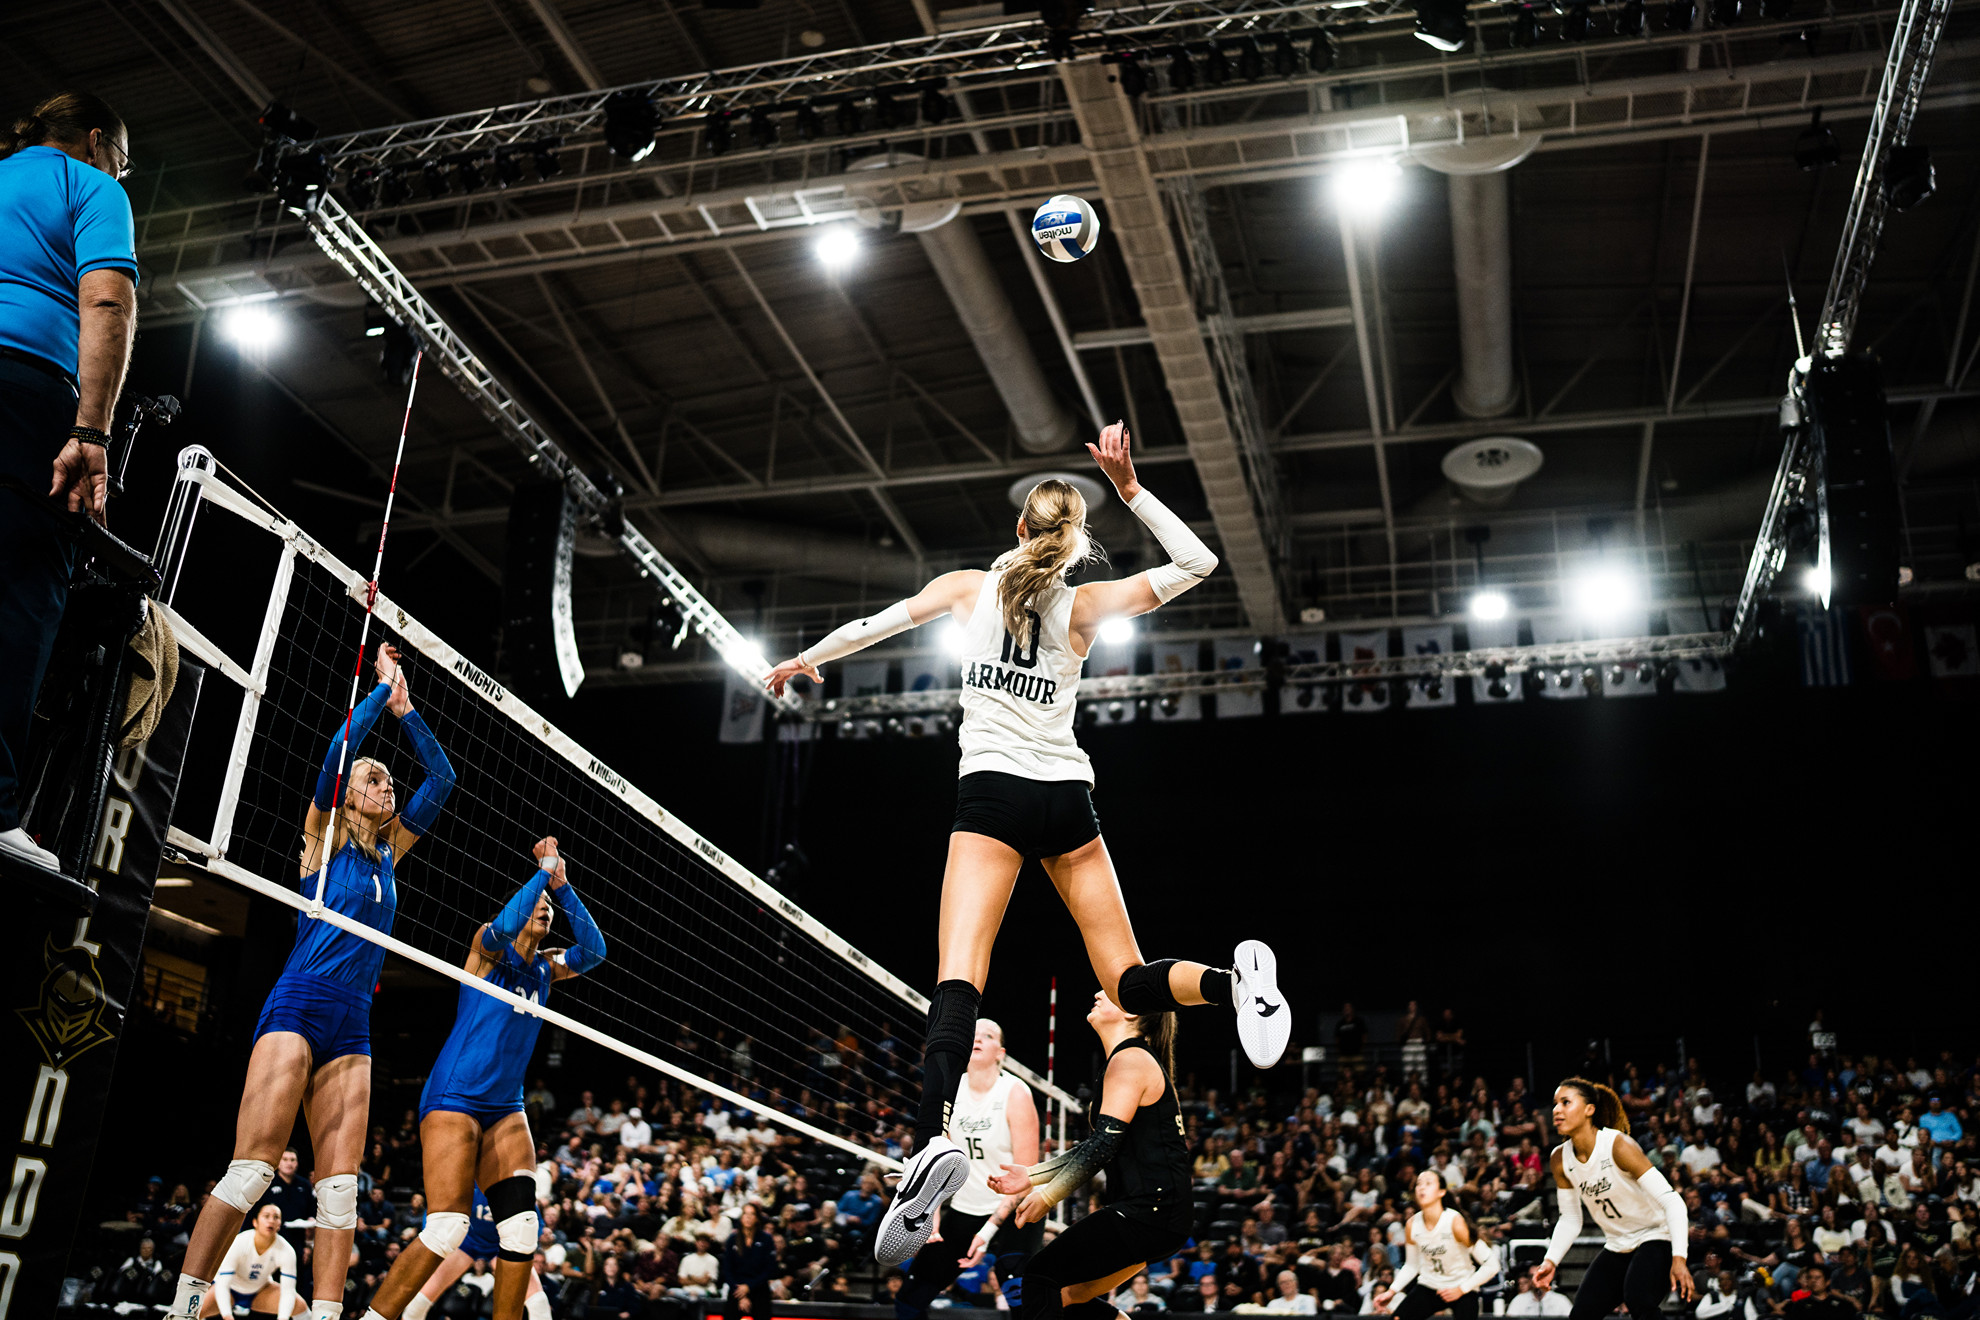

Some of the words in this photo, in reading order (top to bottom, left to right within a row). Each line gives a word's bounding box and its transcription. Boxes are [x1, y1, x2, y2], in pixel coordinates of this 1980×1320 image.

[1038, 226, 1072, 239] molten
[1000, 609, 1041, 669] 10
[453, 655, 505, 702] KNIGHTS
[966, 662, 1057, 704] ARMOUR
[588, 758, 628, 794] KNIGHTS
[372, 873, 383, 903] 1
[958, 1115, 992, 1133] Knights
[965, 1137, 985, 1160] 15
[1579, 1176, 1612, 1197] Knights
[1594, 1198, 1622, 1219] 21
